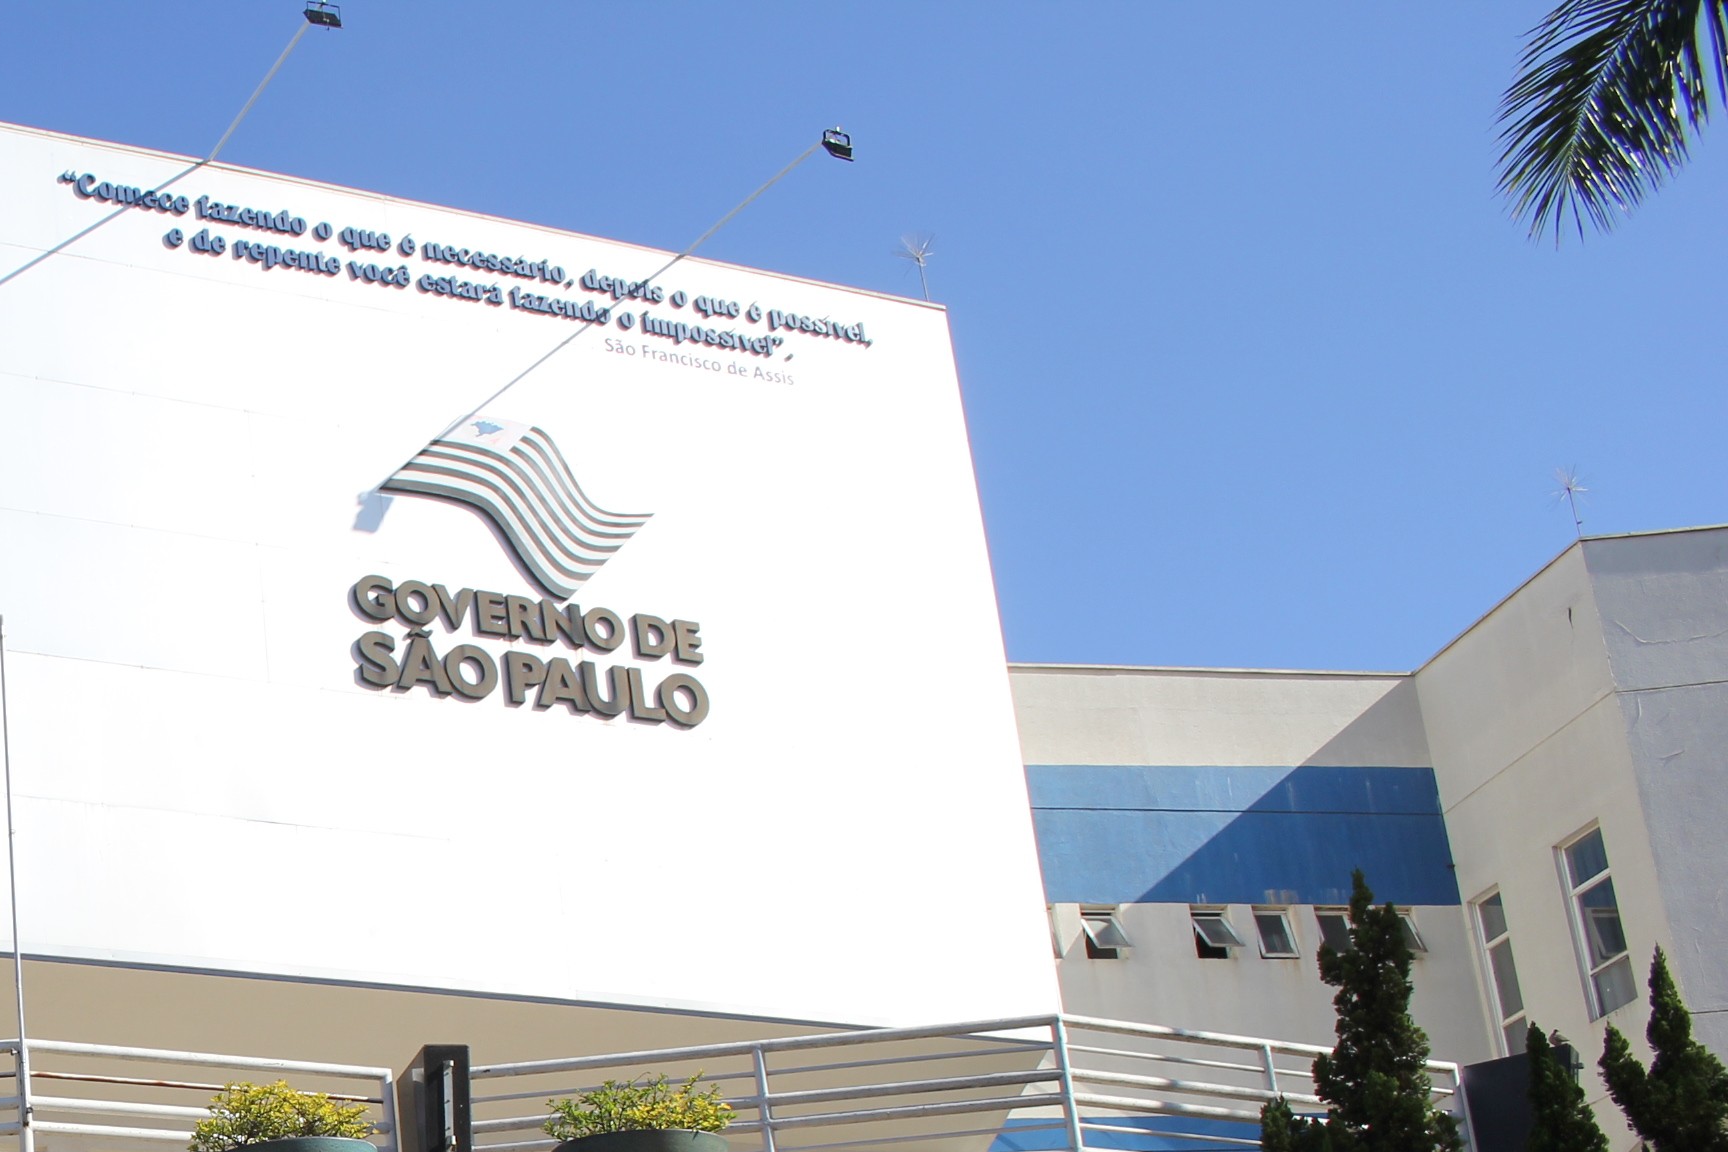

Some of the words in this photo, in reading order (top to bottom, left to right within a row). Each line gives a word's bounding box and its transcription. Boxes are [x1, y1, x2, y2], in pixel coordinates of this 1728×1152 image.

[162, 227, 184, 249] e
[188, 228, 227, 258] de
[232, 238, 341, 278] repente
[346, 259, 411, 291] você
[416, 273, 504, 307] estará
[507, 285, 612, 326] fazendo
[616, 310, 635, 331] o
[194, 194, 307, 236] fazendo
[311, 220, 333, 240] o
[338, 225, 391, 253] que
[398, 233, 416, 258] é
[421, 241, 575, 291] necessário,
[579, 267, 664, 305] depois
[669, 287, 688, 308] o
[693, 293, 740, 320] que
[745, 300, 762, 324] é
[767, 308, 874, 350] possível,
[604, 337, 636, 357] São
[642, 344, 722, 373] Francisco
[727, 361, 748, 378] de
[753, 365, 795, 387] Assis
[348, 573, 626, 656] GOVERNO
[629, 612, 705, 667] DE
[350, 626, 498, 704] SÃO
[500, 650, 710, 731] PAULO
